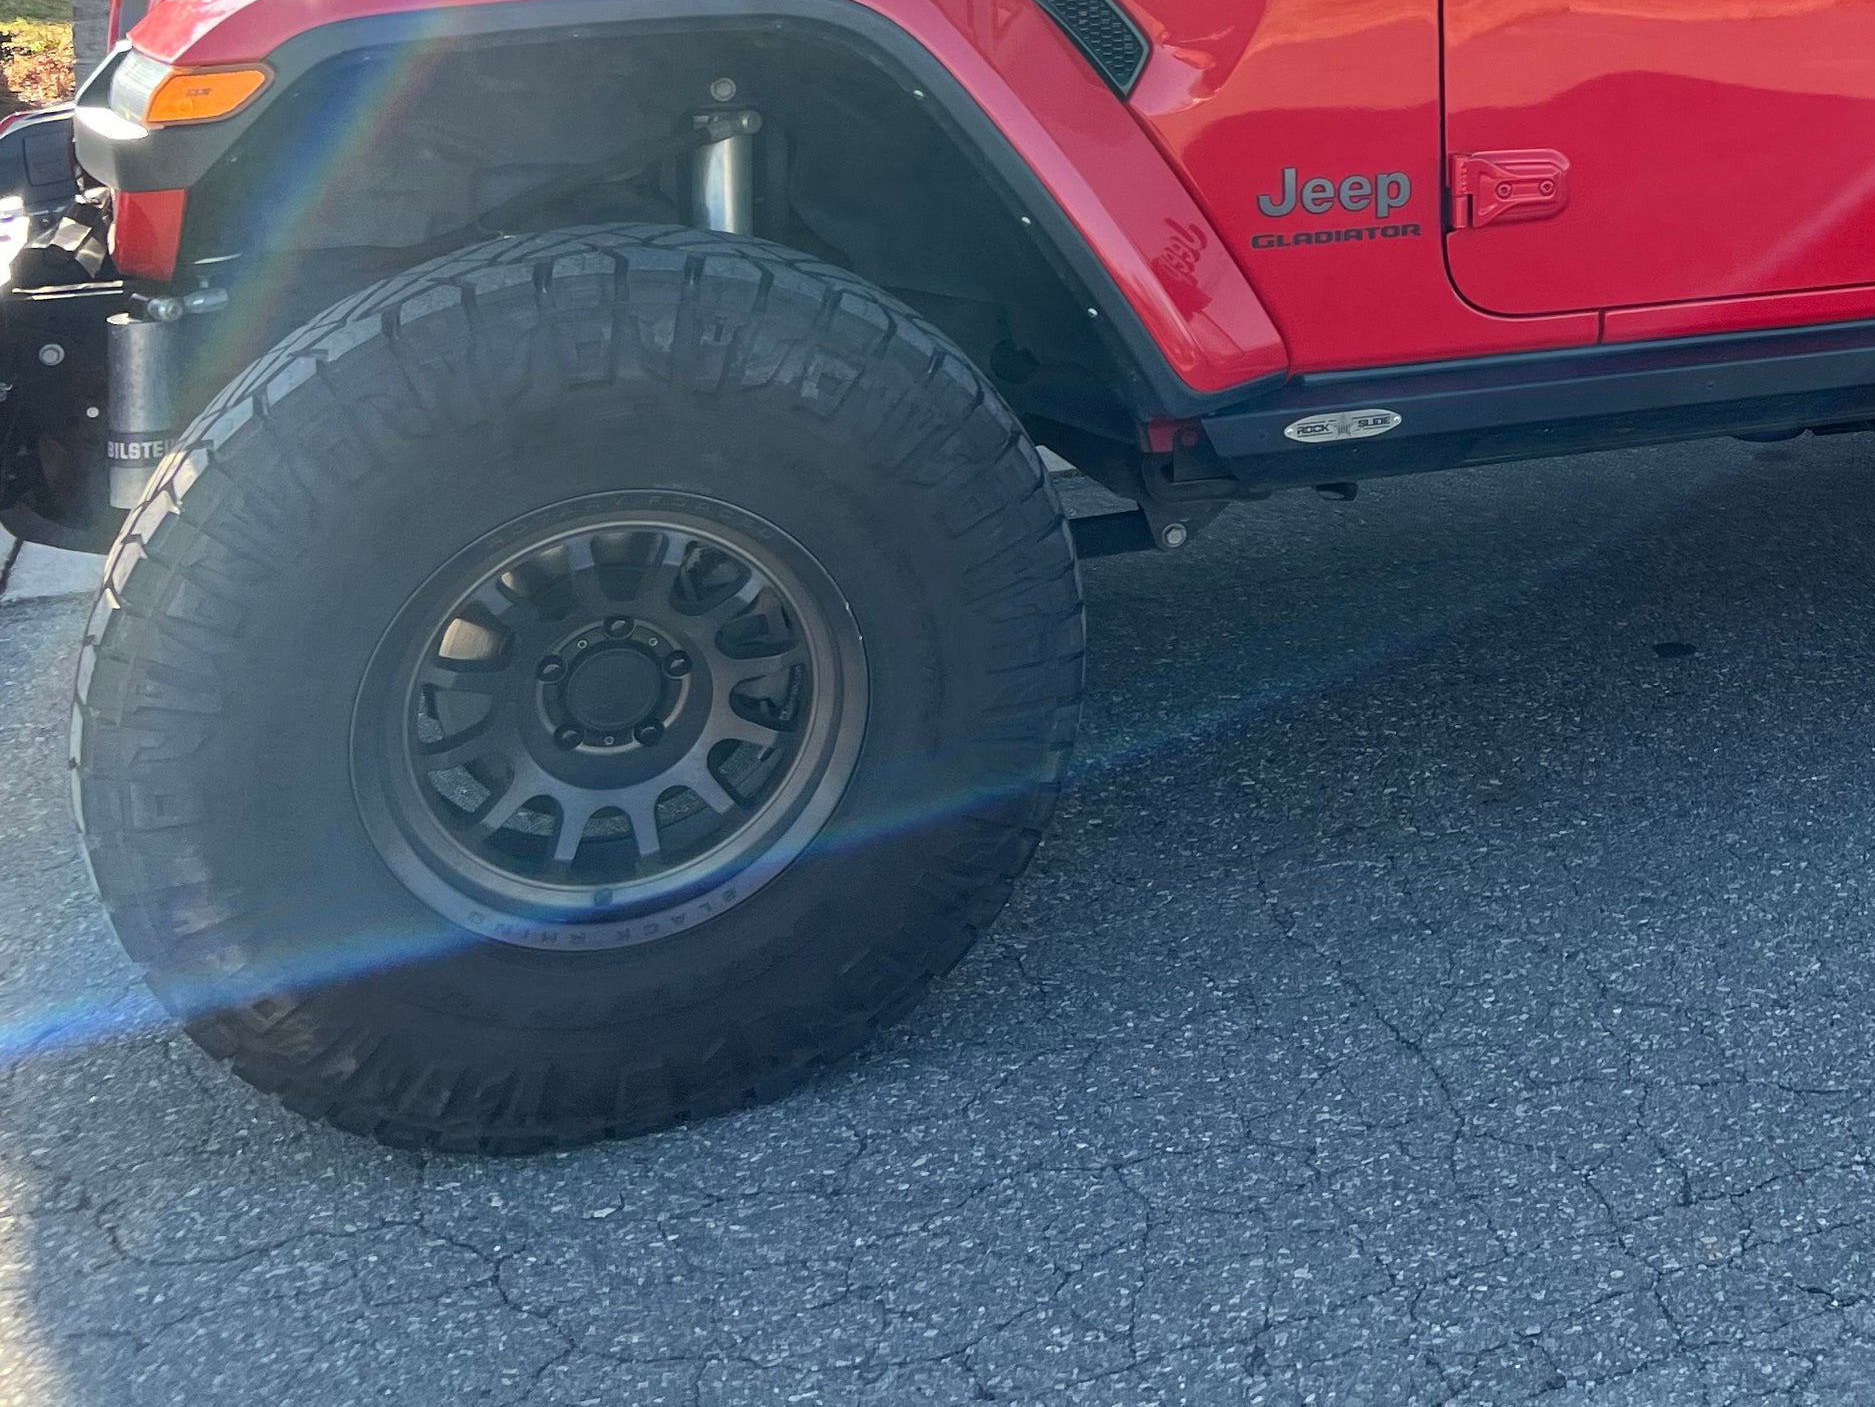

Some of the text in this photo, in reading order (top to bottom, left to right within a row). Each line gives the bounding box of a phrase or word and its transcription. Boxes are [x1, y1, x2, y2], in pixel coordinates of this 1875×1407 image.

[1256, 165, 1413, 220] Jeep
[1251, 223, 1422, 250] GLADIATOR
[1297, 416, 1391, 435] ROCK SLIDE
